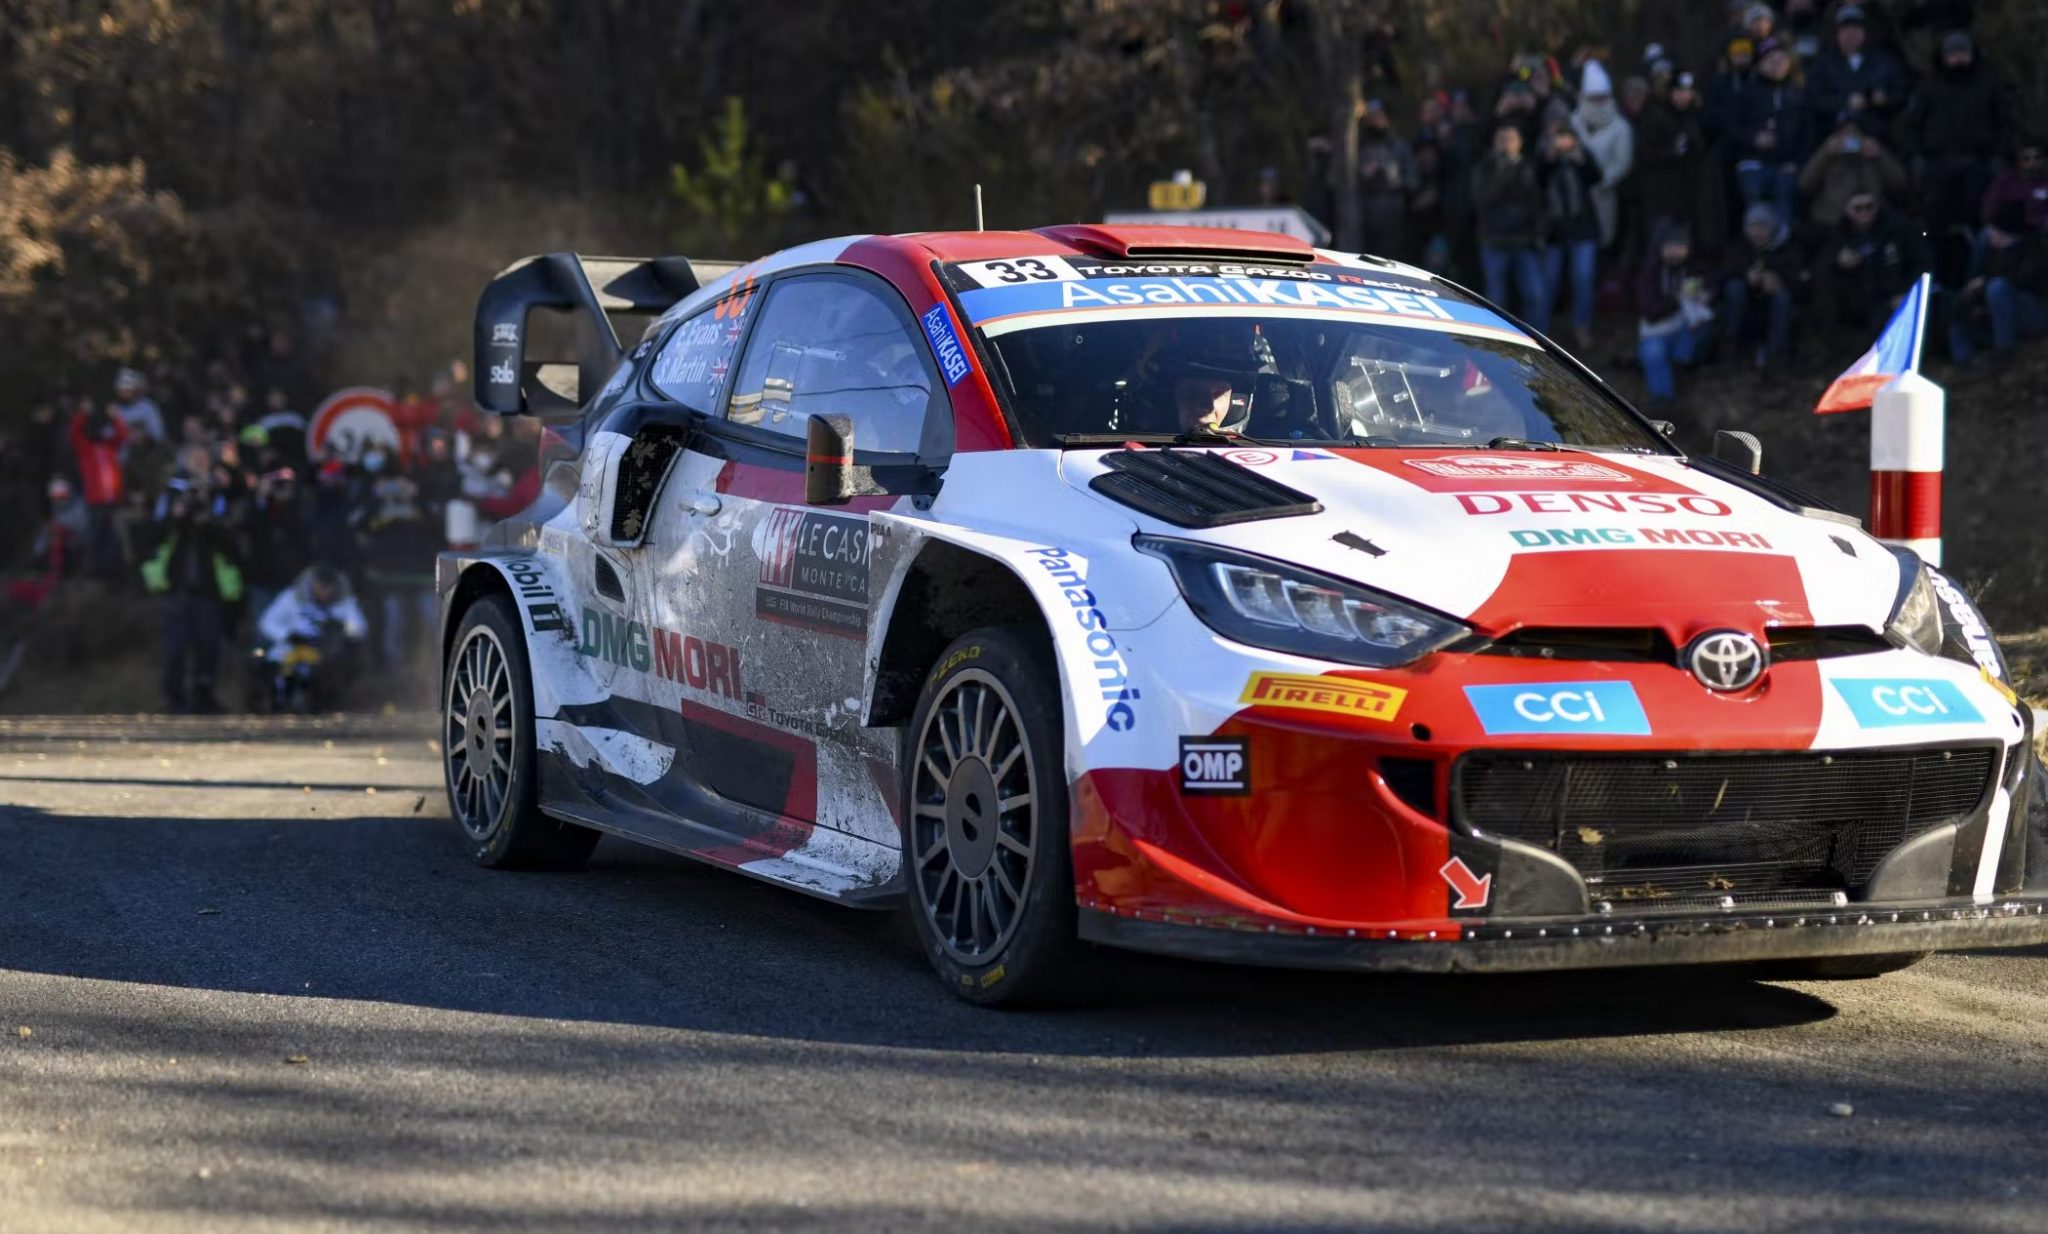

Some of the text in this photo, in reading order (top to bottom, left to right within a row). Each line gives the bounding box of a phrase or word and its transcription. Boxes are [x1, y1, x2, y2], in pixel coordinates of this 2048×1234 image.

[985, 259, 1059, 283] 33
[1078, 264, 1439, 297] TOYOTA GAZOO Racing
[1062, 277, 1454, 320] AsahiKASEI
[925, 307, 968, 383] AsahiKASEI
[1453, 493, 1733, 517] DENSO
[799, 521, 869, 566] LE CASI
[1509, 528, 1774, 550] DMG MORI
[581, 606, 743, 700] DMG MORI
[1027, 548, 1141, 731] Panasonic
[1252, 677, 1392, 713] PIRELLI
[1184, 752, 1243, 780] OMP
